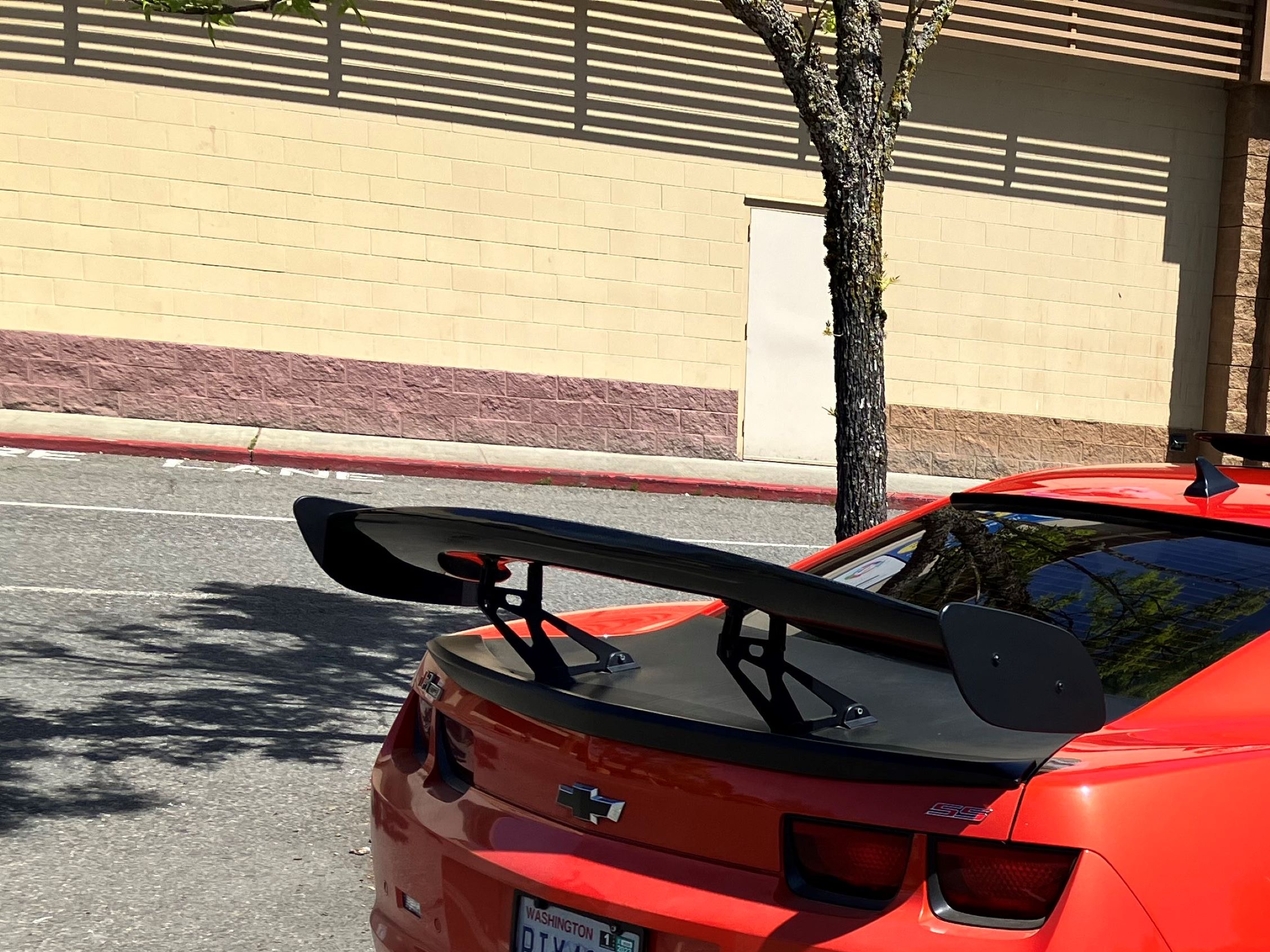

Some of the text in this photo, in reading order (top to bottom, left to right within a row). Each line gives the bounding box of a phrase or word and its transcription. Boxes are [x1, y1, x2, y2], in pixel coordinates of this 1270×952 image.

[162, 459, 384, 482] LANE
[925, 802, 990, 822] SS
[526, 906, 594, 941] WASHINGTON
[604, 933, 610, 946] 1
